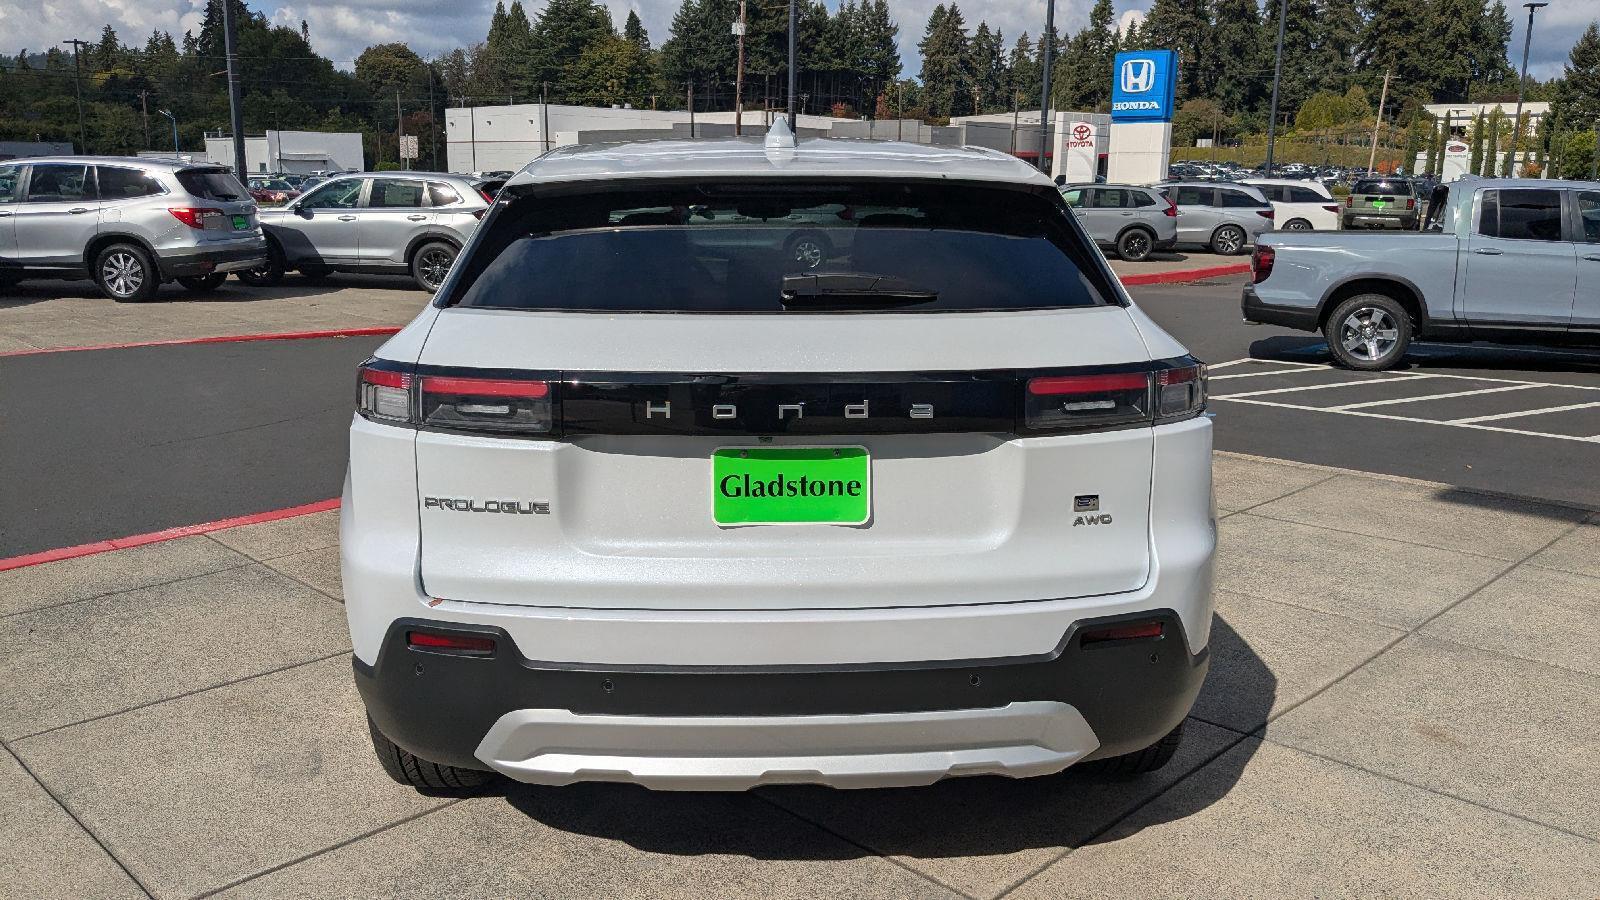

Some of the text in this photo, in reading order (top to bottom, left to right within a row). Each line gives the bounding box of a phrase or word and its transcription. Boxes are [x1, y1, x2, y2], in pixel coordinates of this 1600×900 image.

[1112, 101, 1160, 110] HONDA
[1069, 140, 1093, 148] TOYOTA
[720, 473, 862, 498] Gladstone
[424, 496, 550, 514] PROLOGUE
[1073, 514, 1112, 527] AWD
